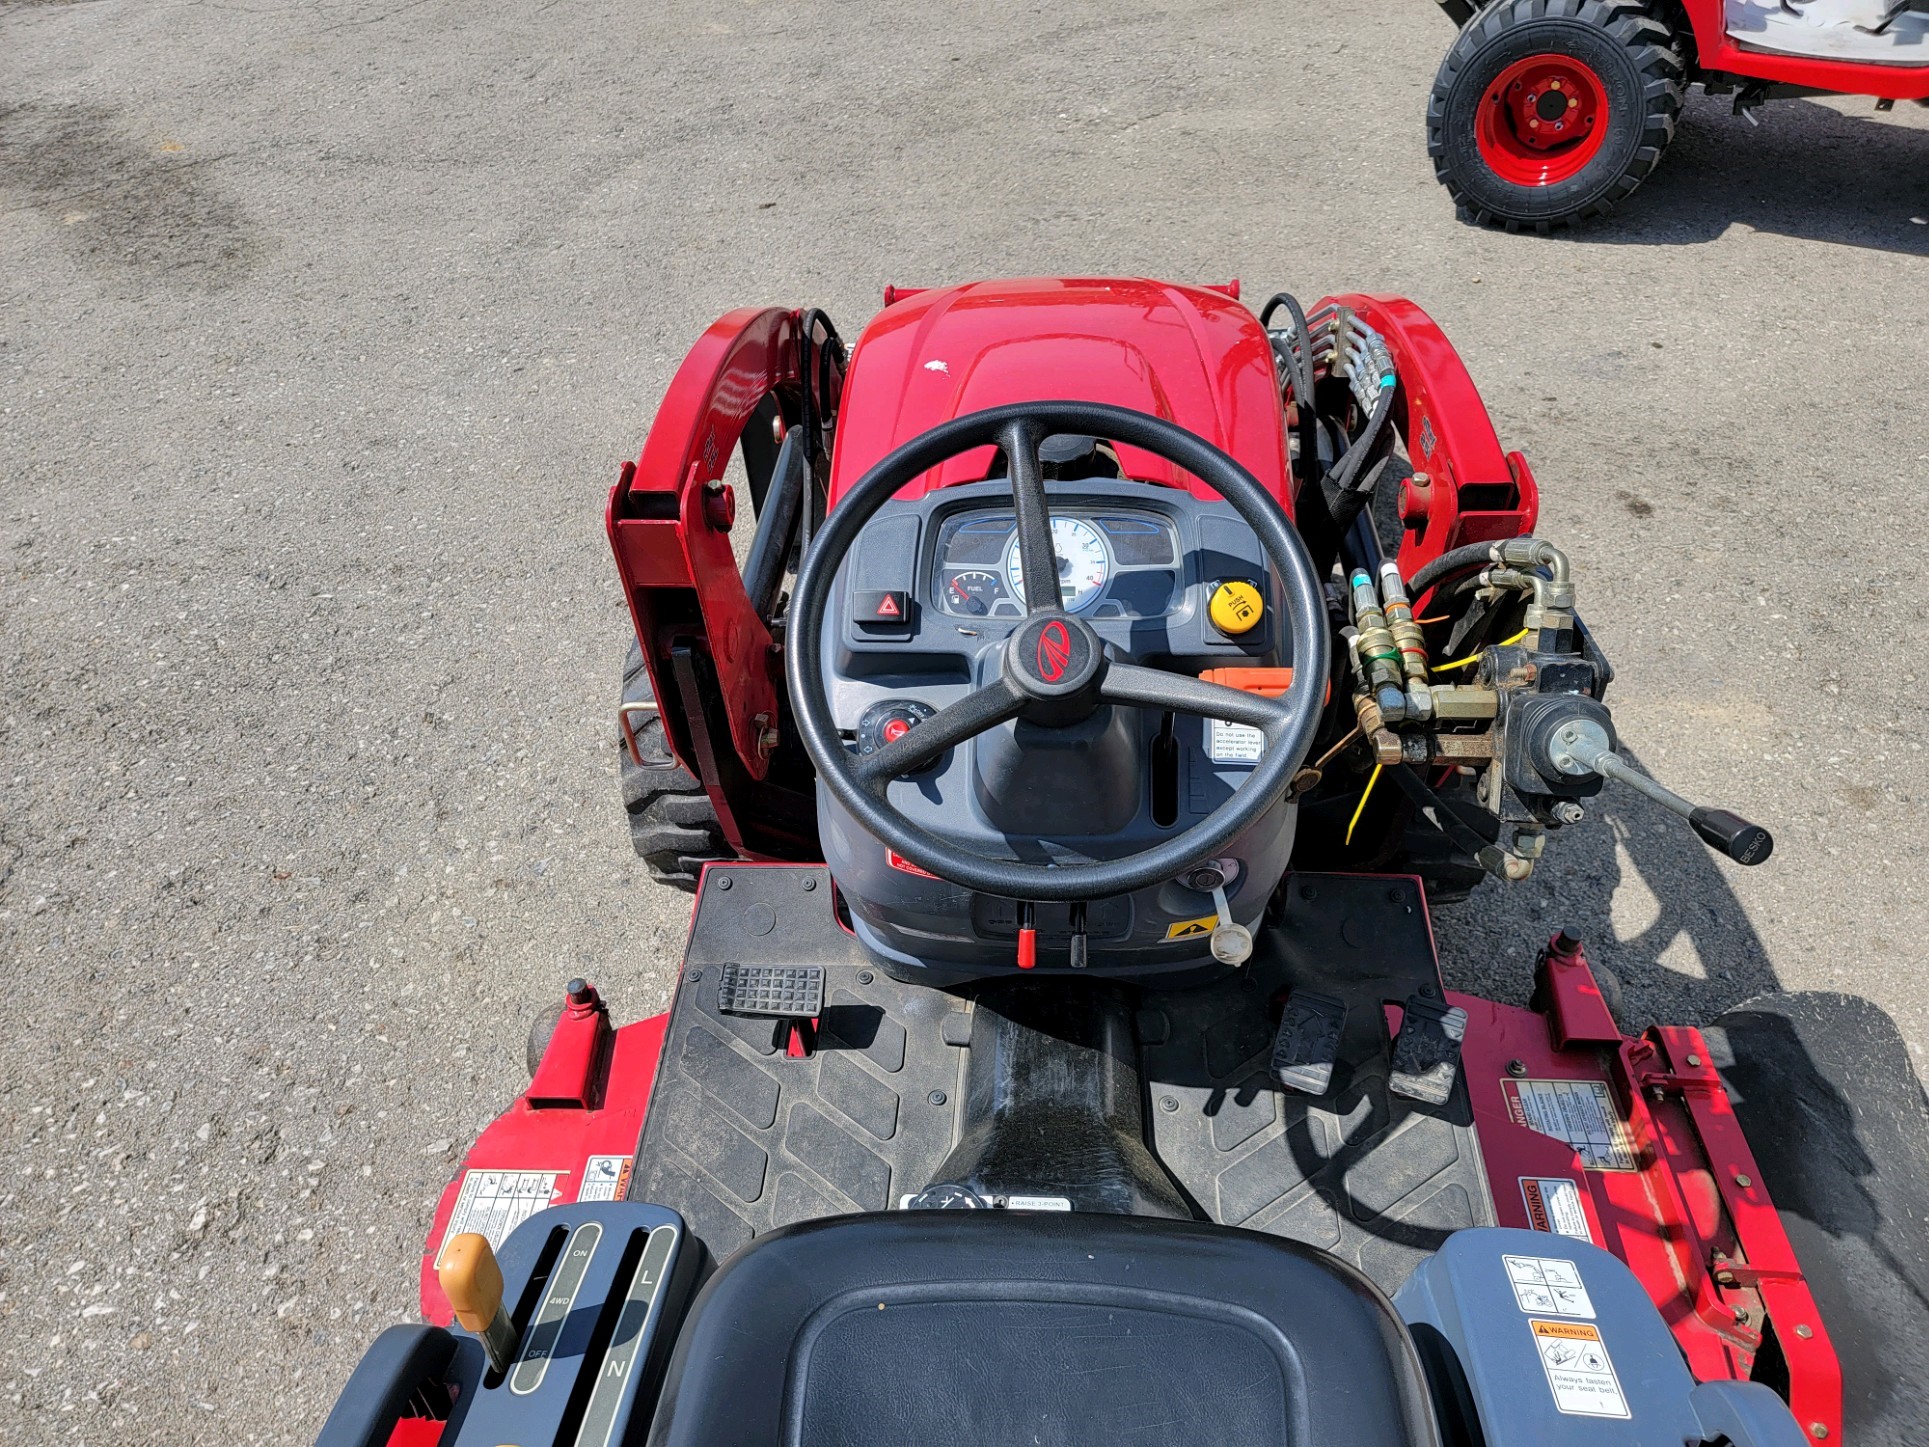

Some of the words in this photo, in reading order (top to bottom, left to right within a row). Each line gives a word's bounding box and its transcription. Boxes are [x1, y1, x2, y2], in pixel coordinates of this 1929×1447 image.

[1228, 595, 1244, 607] PUSH
[1740, 831, 1766, 863] BESKO
[1510, 1095, 1527, 1127] NGER
[640, 1270, 653, 1285] L
[549, 1297, 569, 1305] 4WD
[1549, 1327, 1594, 1337] WARNING
[607, 1360, 626, 1377] N
[1554, 1374, 1583, 1383] Always
[1585, 1377, 1612, 1386] fasten
